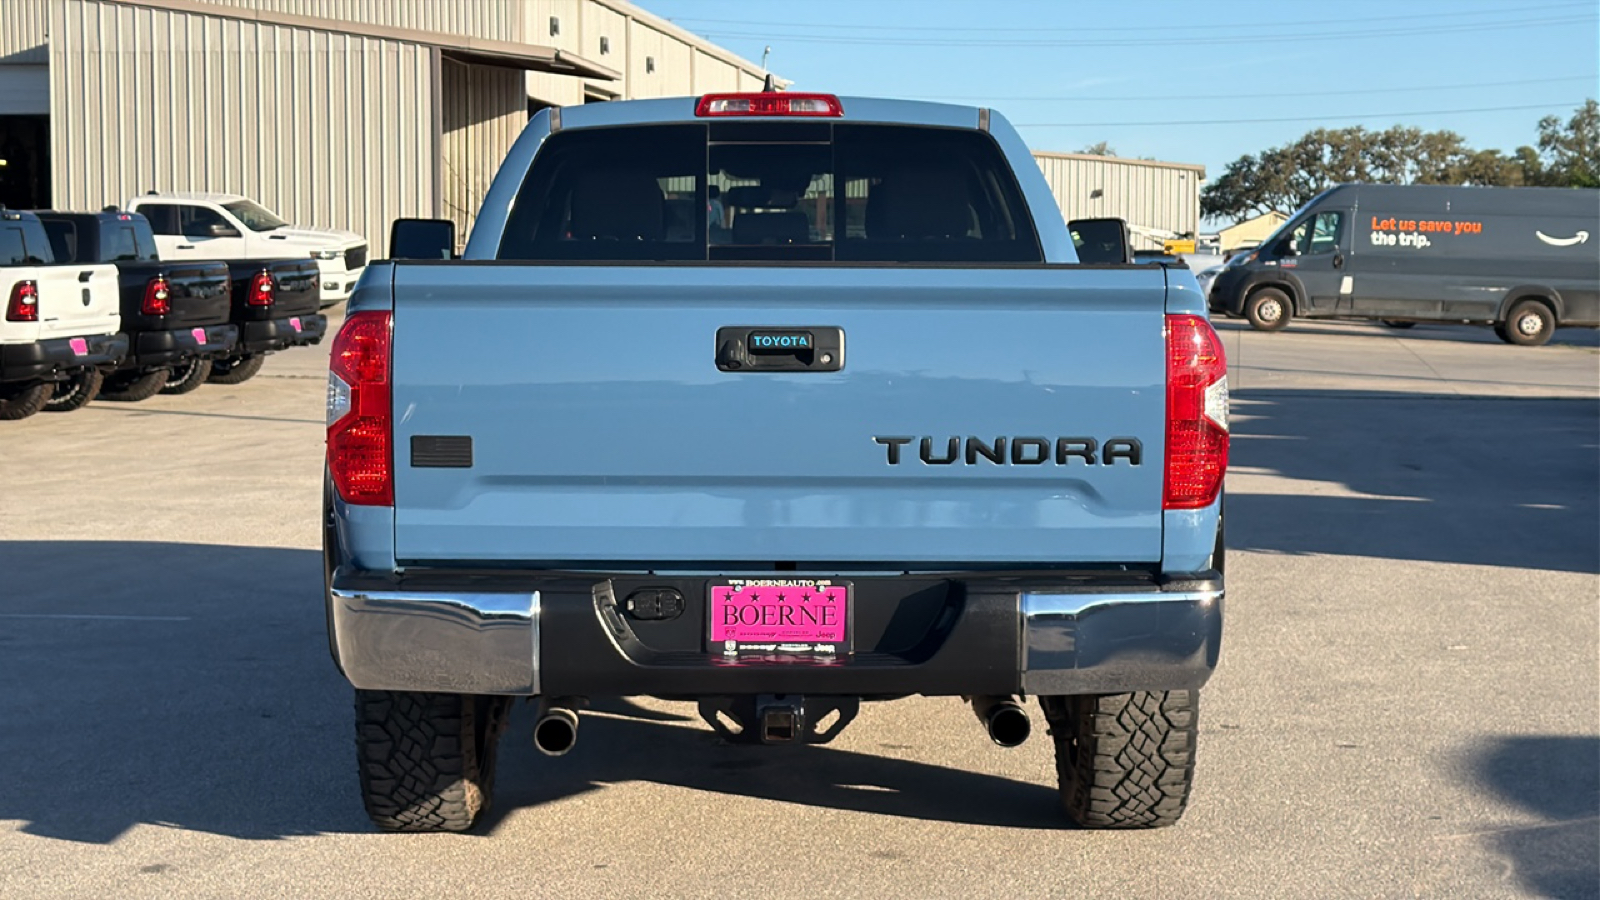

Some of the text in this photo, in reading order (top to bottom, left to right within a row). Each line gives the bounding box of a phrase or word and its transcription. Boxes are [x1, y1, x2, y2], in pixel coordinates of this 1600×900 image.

[1371, 216, 1482, 235] Let us save you
[1371, 231, 1431, 249] the trip.
[754, 335, 808, 346] TOYOTA
[872, 436, 1142, 466] TUNDRA
[721, 604, 838, 626] BOERNE
[816, 630, 836, 639] Jeep
